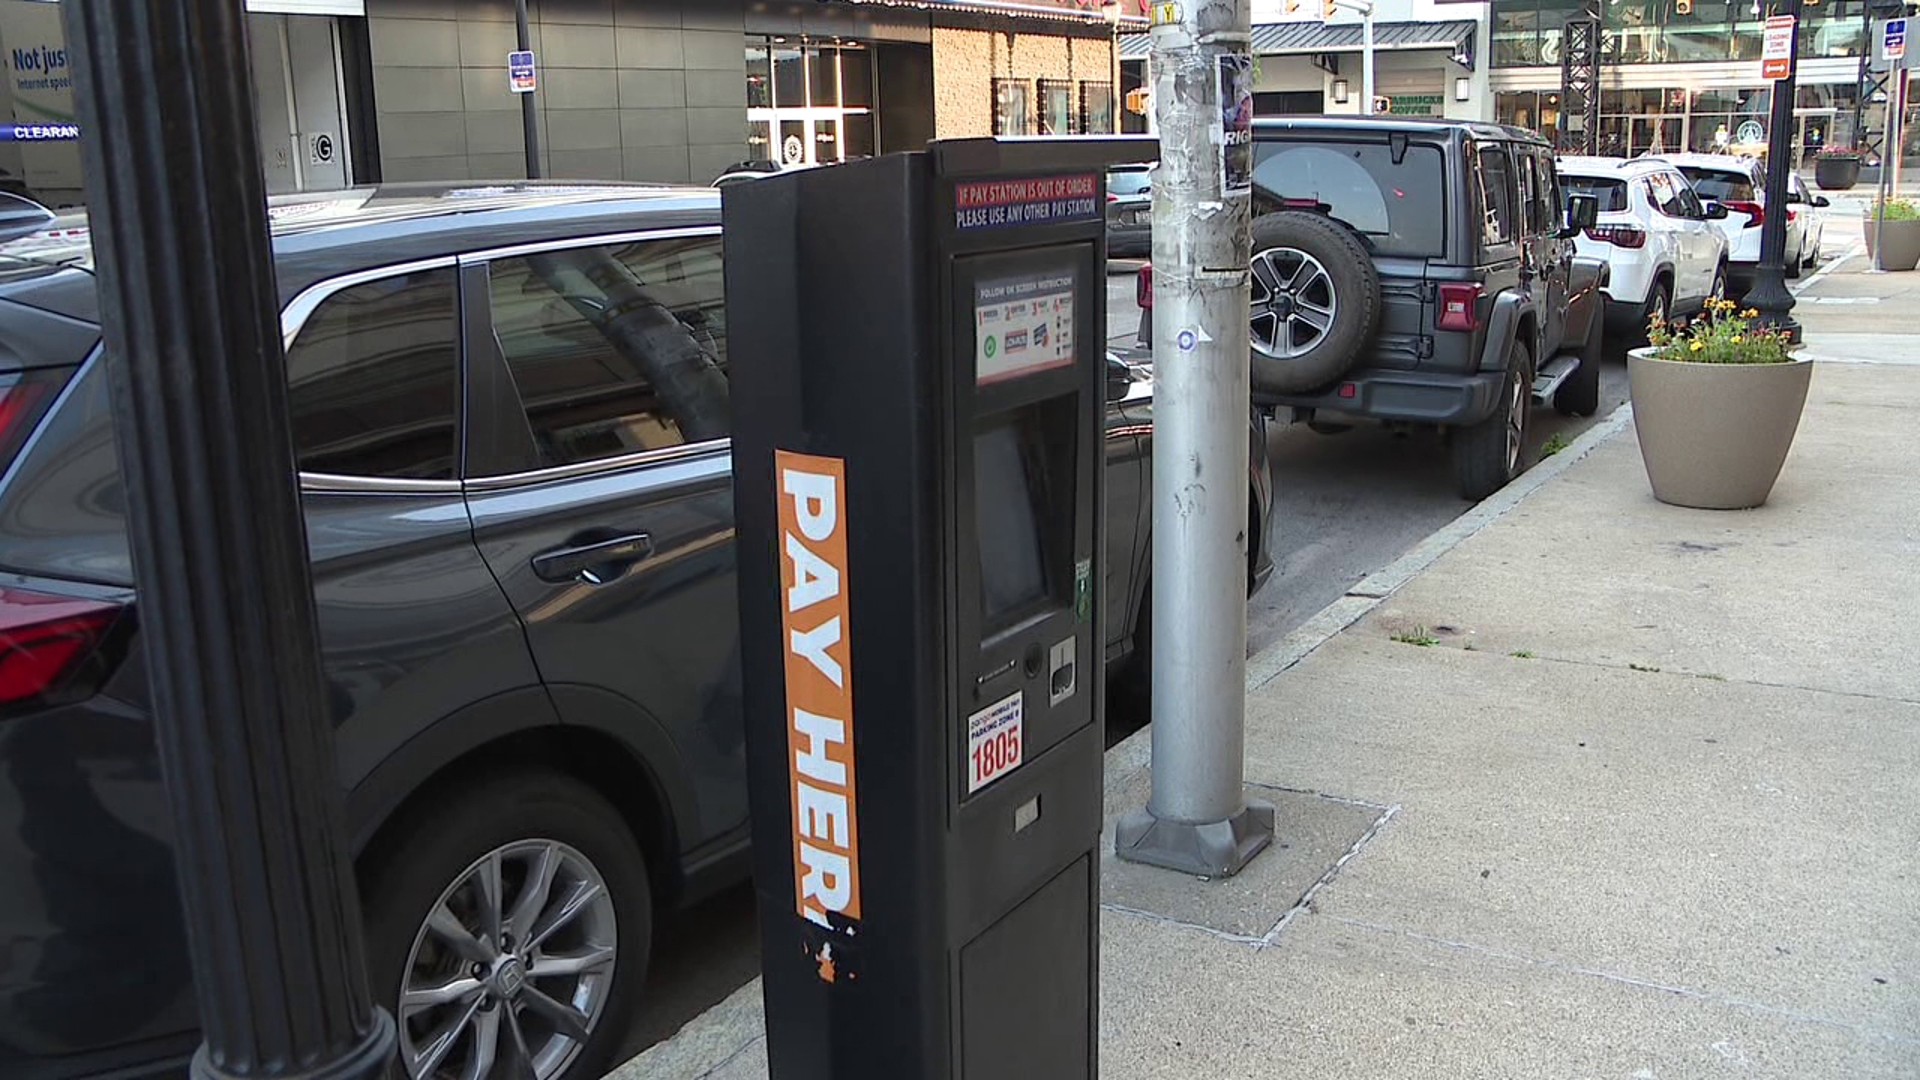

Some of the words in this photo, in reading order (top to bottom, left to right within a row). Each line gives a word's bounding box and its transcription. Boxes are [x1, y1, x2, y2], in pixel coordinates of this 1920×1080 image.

[13, 48, 41, 71] Not
[1391, 105, 1431, 115] COFFEE
[319, 138, 331, 159] G
[959, 187, 969, 204] IF
[970, 185, 988, 203] PAY
[989, 182, 1027, 201] STATION
[1028, 182, 1036, 198] IS
[1037, 181, 1053, 197] OUT
[1054, 180, 1066, 196] OF
[1067, 178, 1093, 194] ORDER
[956, 210, 988, 229] PLEASE
[989, 208, 1005, 225] USE
[1006, 206, 1024, 222] ANY
[1024, 203, 1050, 220] OTHER
[1052, 201, 1066, 217] PAY
[1067, 197, 1096, 214] STATION
[980, 287, 1005, 299] FOLLOW
[783, 468, 842, 689] PAY
[971, 720, 997, 740] PARKING
[998, 712, 1014, 727] ZONE
[972, 724, 1019, 782] 1805
[793, 707, 851, 931] HER
